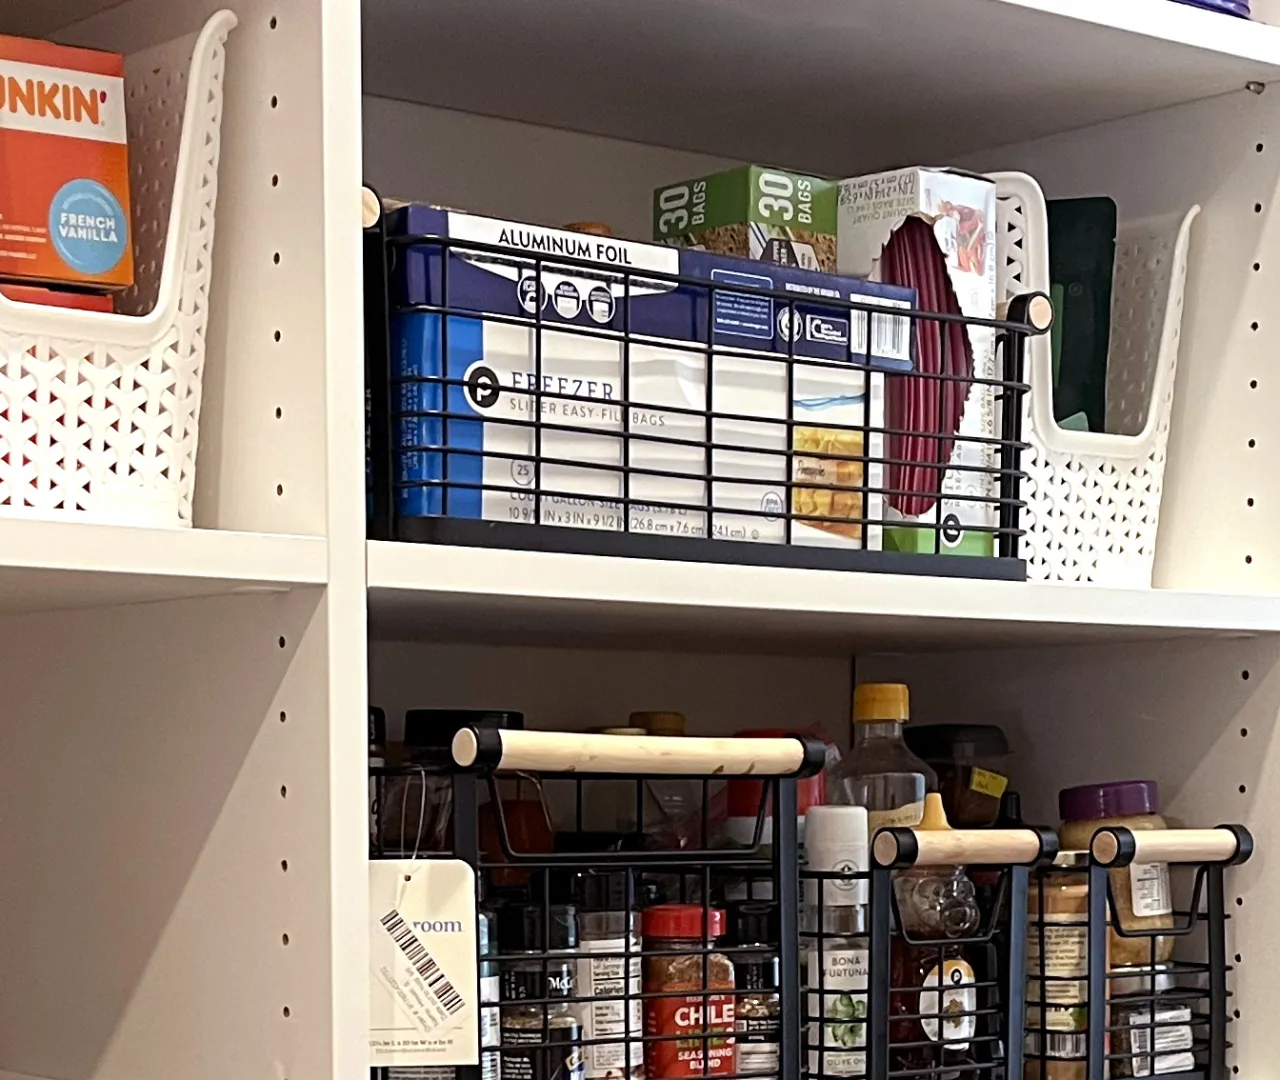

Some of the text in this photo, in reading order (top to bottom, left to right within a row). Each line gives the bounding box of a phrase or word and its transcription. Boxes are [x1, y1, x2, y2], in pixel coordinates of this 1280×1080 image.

[759, 172, 812, 223] 30 BAGS
[659, 181, 706, 233] 30 BAGS
[60, 212, 116, 230] FRENCH
[59, 225, 118, 243] VANILLA
[498, 227, 632, 265] ALUMINUM FOIL
[632, 411, 666, 427] BAGS
[508, 507, 520, 520] 10
[544, 510, 556, 522] IN
[564, 511, 572, 524] 3
[572, 511, 586, 525] IN
[592, 513, 600, 527] 9
[630, 518, 654, 532] (26.8
[655, 522, 669, 532] cm
[676, 520, 690, 534] 7.6
[690, 525, 704, 536] cm
[831, 956, 861, 967] BONA
[674, 1003, 735, 1027] CHILE
[678, 1048, 733, 1061] SEASNING
[689, 1058, 721, 1070] BLND
